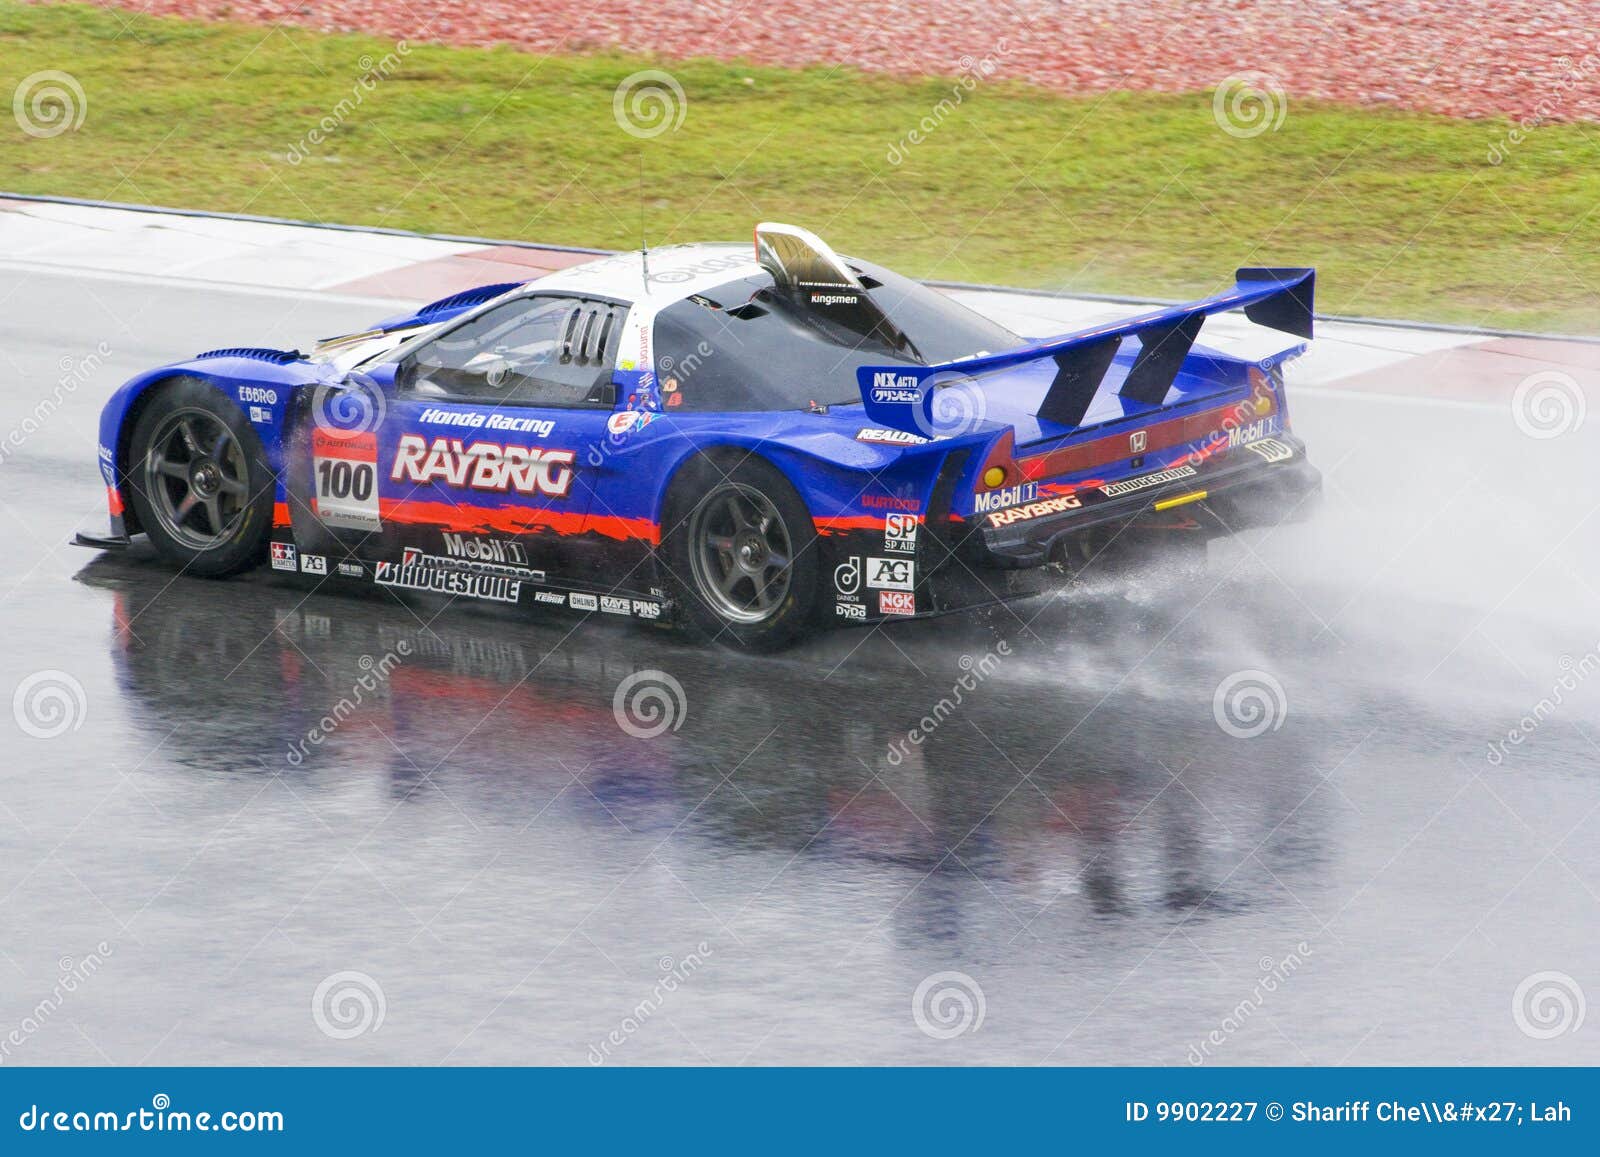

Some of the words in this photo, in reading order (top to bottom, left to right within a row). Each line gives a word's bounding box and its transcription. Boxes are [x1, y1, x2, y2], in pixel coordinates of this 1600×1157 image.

[873, 372, 897, 388] NX
[239, 386, 277, 405] EBBRO
[419, 408, 486, 428] Honda
[484, 413, 556, 438] Racing
[1229, 418, 1264, 447] Mobil
[1247, 439, 1291, 462] 100
[391, 433, 576, 496] RAYBRIG
[319, 460, 373, 501] 100
[1099, 465, 1197, 497] BRIDGESTONE
[974, 485, 1021, 513] Mobil
[988, 495, 1082, 528] RAYBRIG
[886, 514, 917, 539] SP
[442, 532, 505, 563] Mobil
[884, 540, 898, 550] SP
[899, 541, 915, 551] AIR
[305, 556, 323, 570] AG
[374, 548, 545, 603] BRIDGESTONE
[872, 560, 909, 583] AG
[600, 597, 630, 610] RAYS
[835, 604, 866, 618] DyDo
[880, 593, 914, 609] NGK
